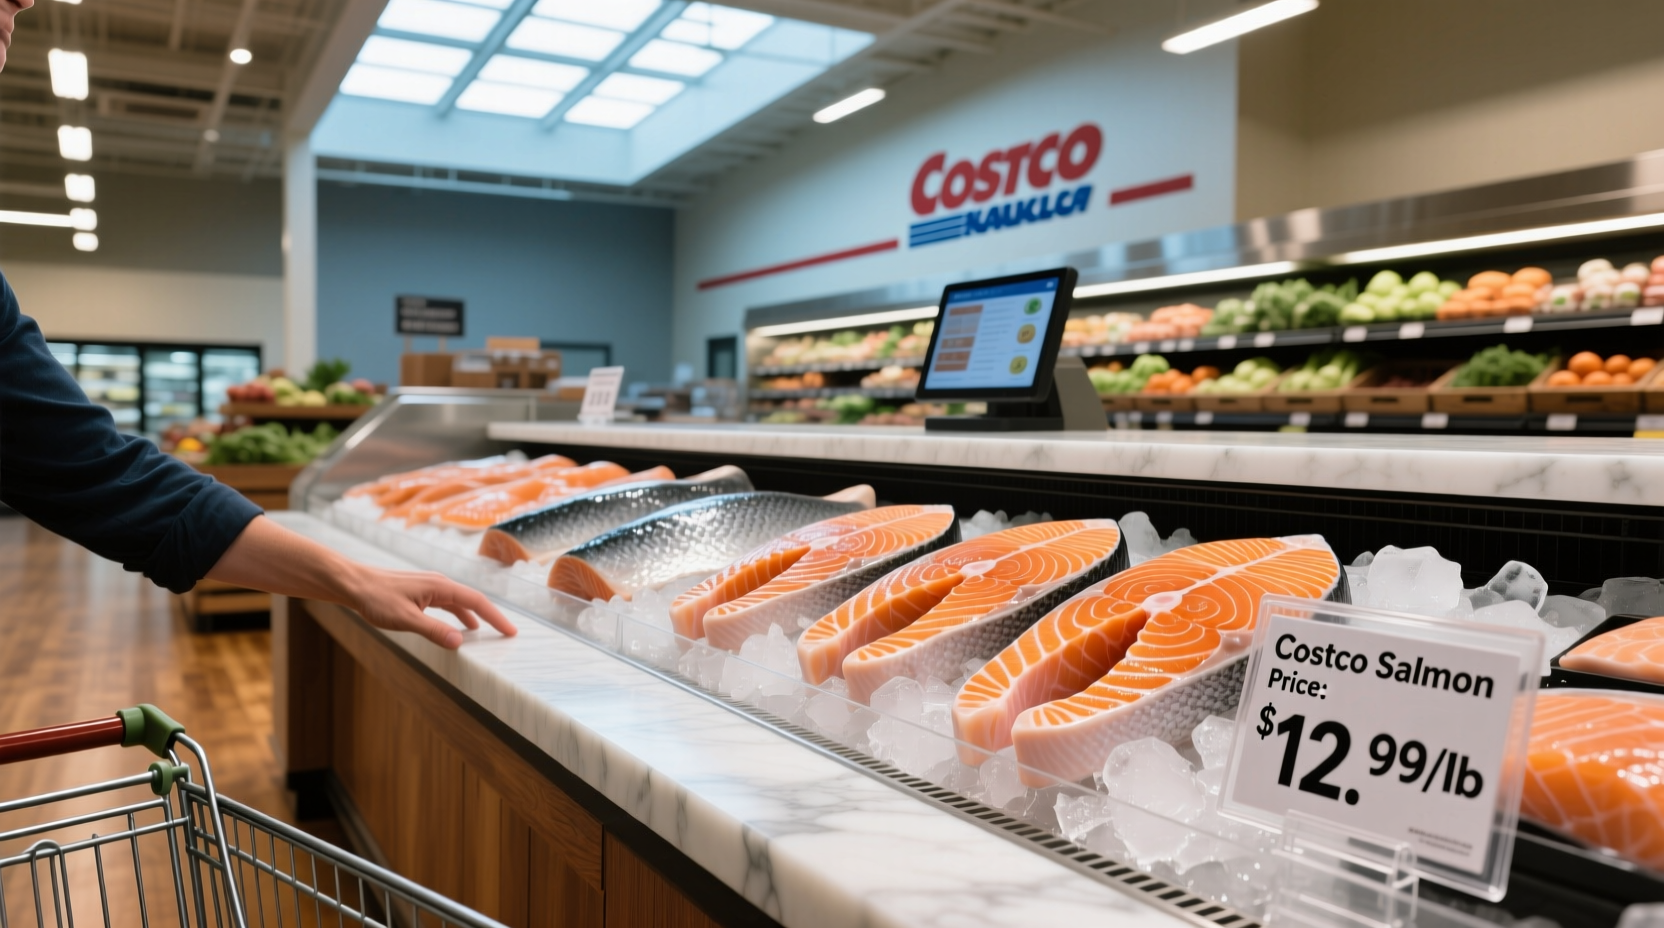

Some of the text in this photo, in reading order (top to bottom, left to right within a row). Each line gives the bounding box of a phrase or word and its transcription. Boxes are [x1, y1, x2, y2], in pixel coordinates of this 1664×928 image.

[910, 122, 1103, 216] COSTCO
[1268, 668, 1327, 699] Price:
[1275, 633, 1494, 698] Costco Salmon
